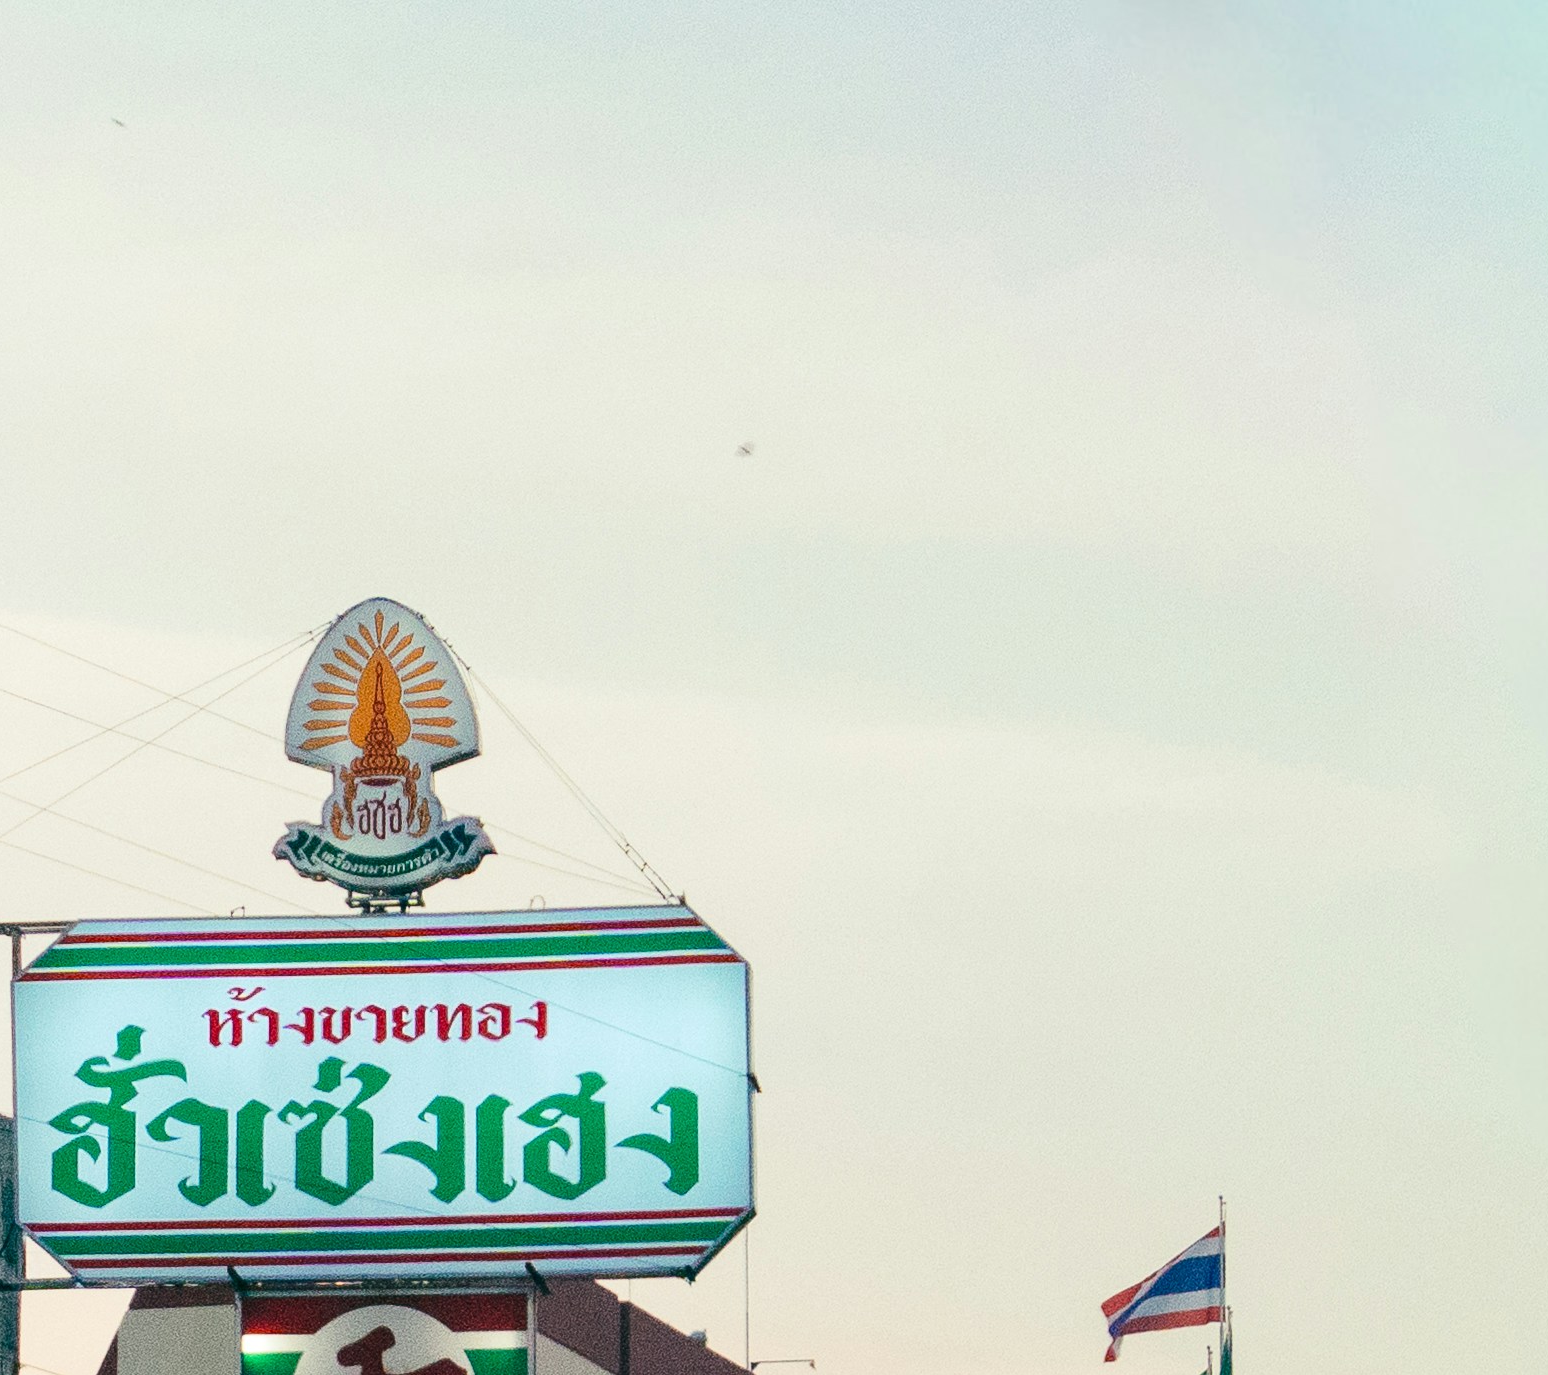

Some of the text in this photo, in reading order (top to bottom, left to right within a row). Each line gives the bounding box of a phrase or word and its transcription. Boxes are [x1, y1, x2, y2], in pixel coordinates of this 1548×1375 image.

[202, 985, 550, 1048] ห้างขายทอง
[46, 1024, 701, 1207] ฮั่วเซ่งเฮง
